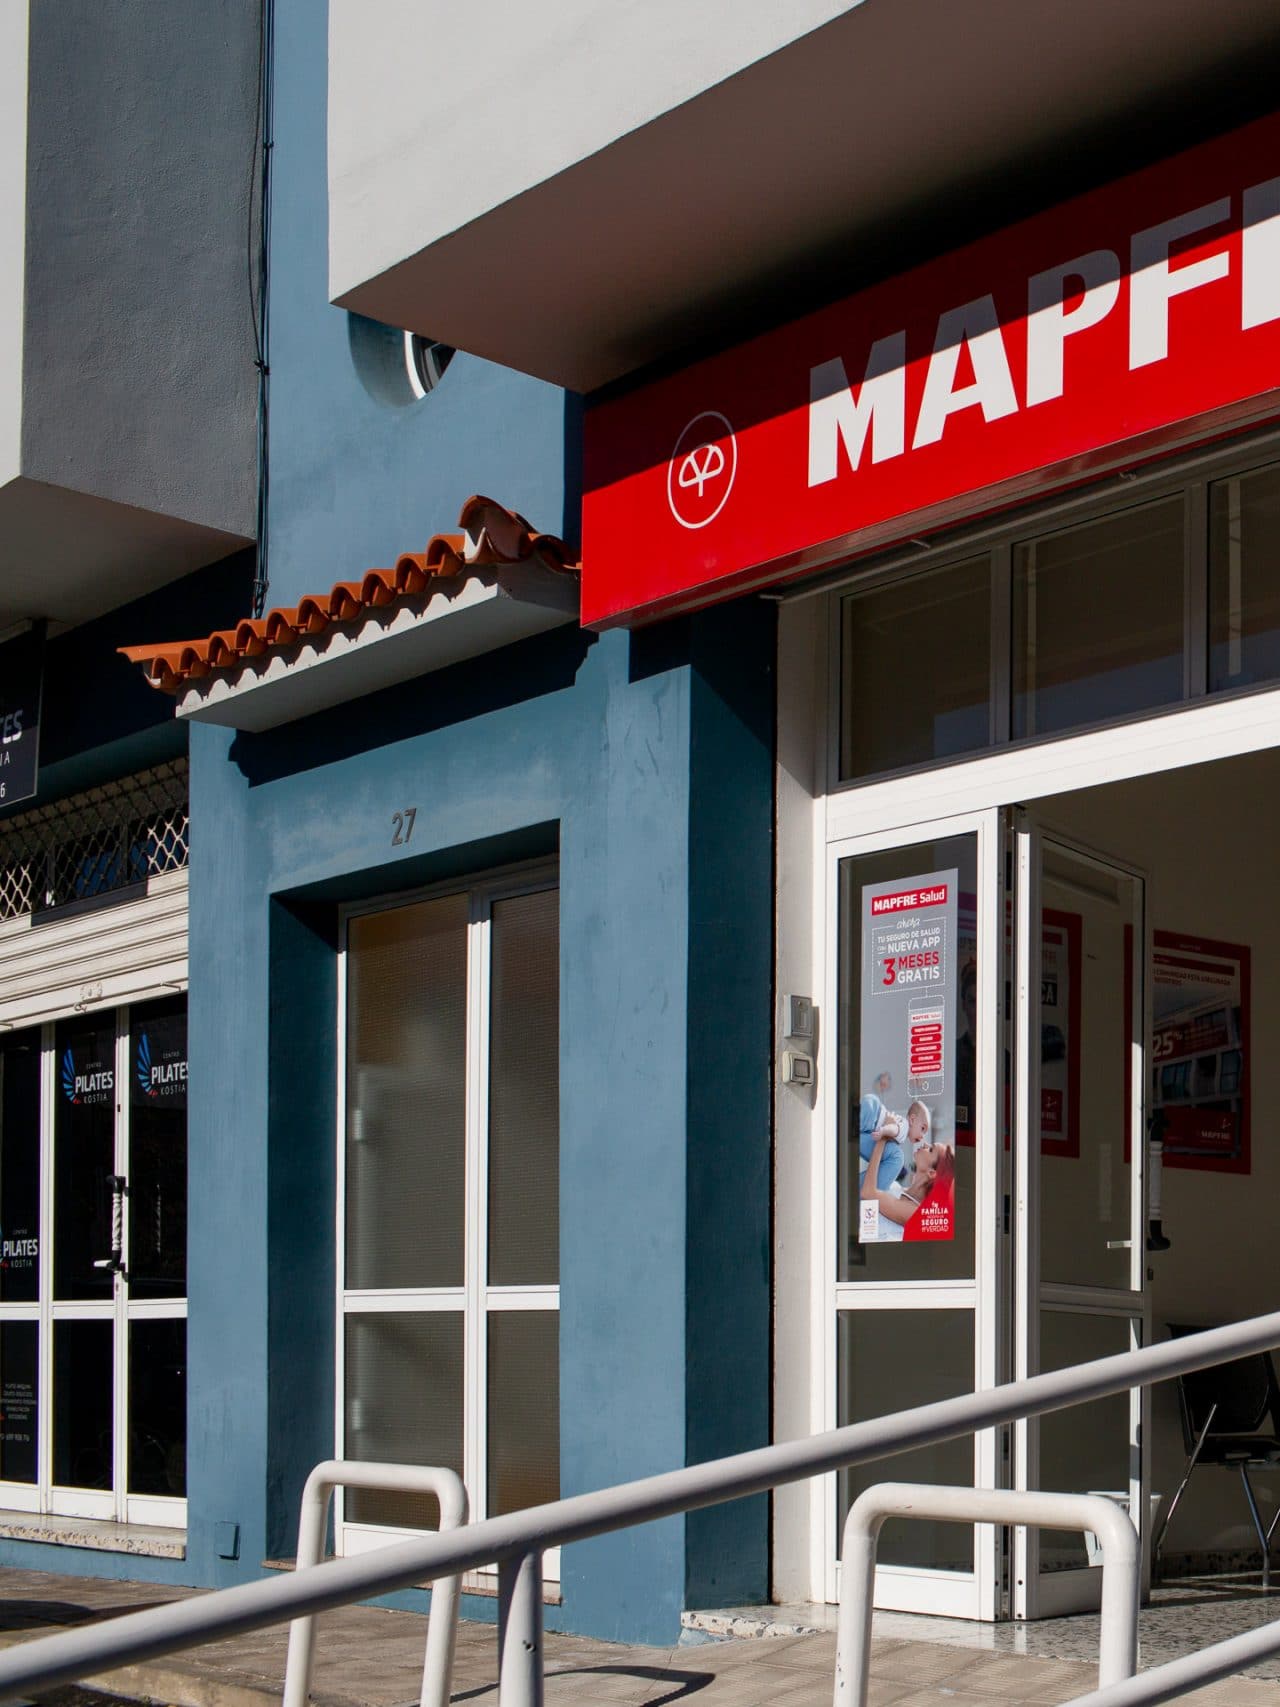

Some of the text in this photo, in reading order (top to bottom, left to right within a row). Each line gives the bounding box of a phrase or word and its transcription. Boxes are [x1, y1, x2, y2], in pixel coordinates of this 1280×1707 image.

[0, 710, 23, 744] ES
[391, 807, 417, 847] 27
[874, 888, 945, 912] MAPFRE Salud
[878, 927, 941, 944] TU SEGURO DE SALUD
[888, 938, 920, 954] NUEVA
[921, 935, 941, 949] APP
[882, 957, 897, 986] 3
[898, 950, 940, 970] MESES
[897, 965, 940, 984] GRATIS
[75, 1071, 114, 1093] PILATES
[161, 1084, 186, 1096] KOSTIA
[83, 1093, 108, 1104] KOSTIA
[921, 1218, 949, 1226] SEGURO
[3, 1239, 38, 1257] PILATES
